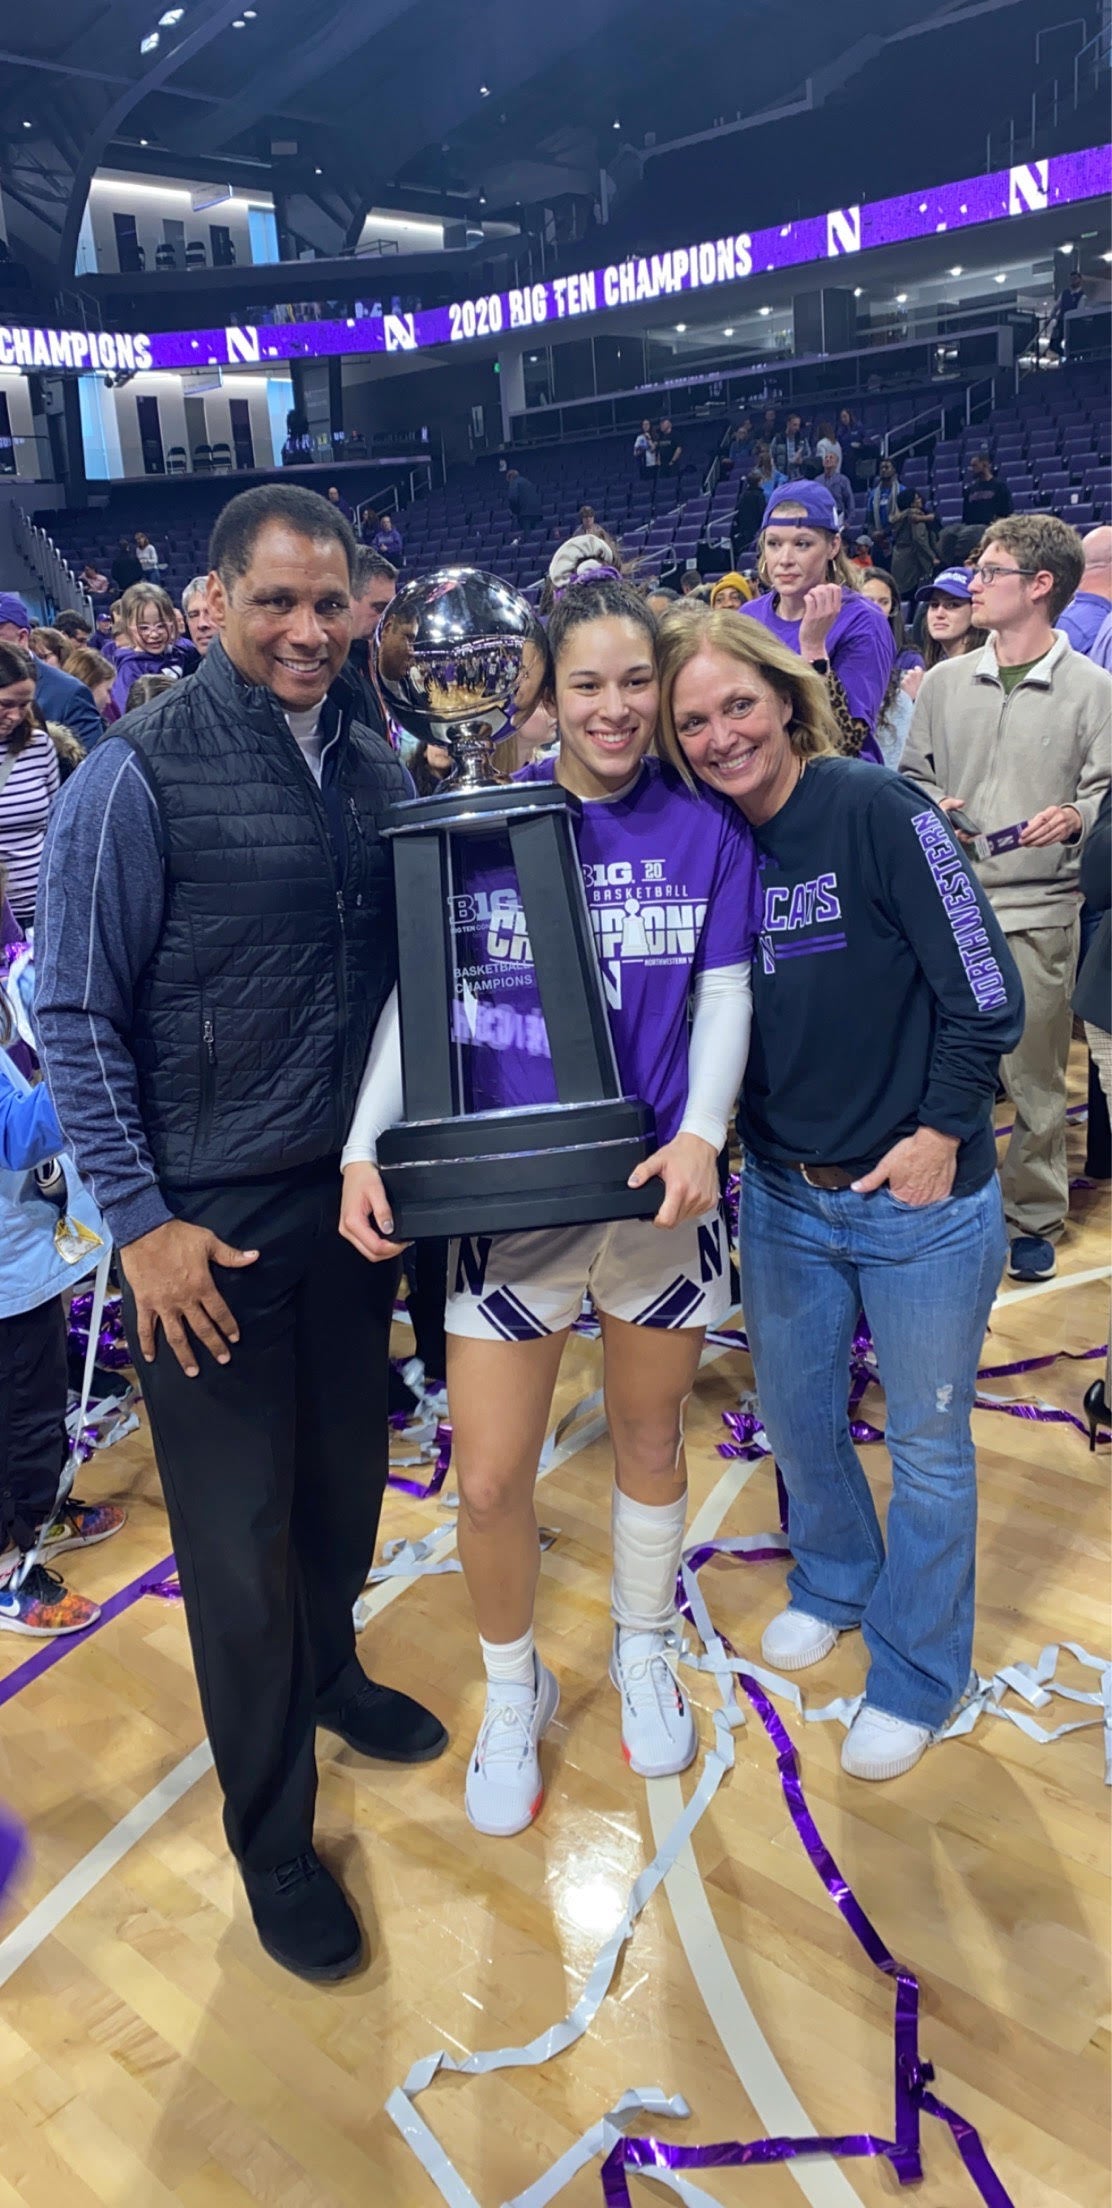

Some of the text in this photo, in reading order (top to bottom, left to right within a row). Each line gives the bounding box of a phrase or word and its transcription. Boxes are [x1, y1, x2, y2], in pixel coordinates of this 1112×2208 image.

[1008, 159, 1049, 215] N
[827, 205, 861, 257] N
[448, 231, 753, 341] 2020 BIG TEN CHAMPIONS
[0, 326, 153, 369] CHAMPIONS
[226, 326, 259, 362] N
[384, 314, 417, 351] N
[593, 884, 689, 901] BASKETBALL
[645, 863, 663, 879] 20
[764, 872, 842, 932] CATS
[910, 808, 1008, 1012] NORTHWESTERN
[455, 1235, 493, 1297] N
[697, 1219, 723, 1284] N
